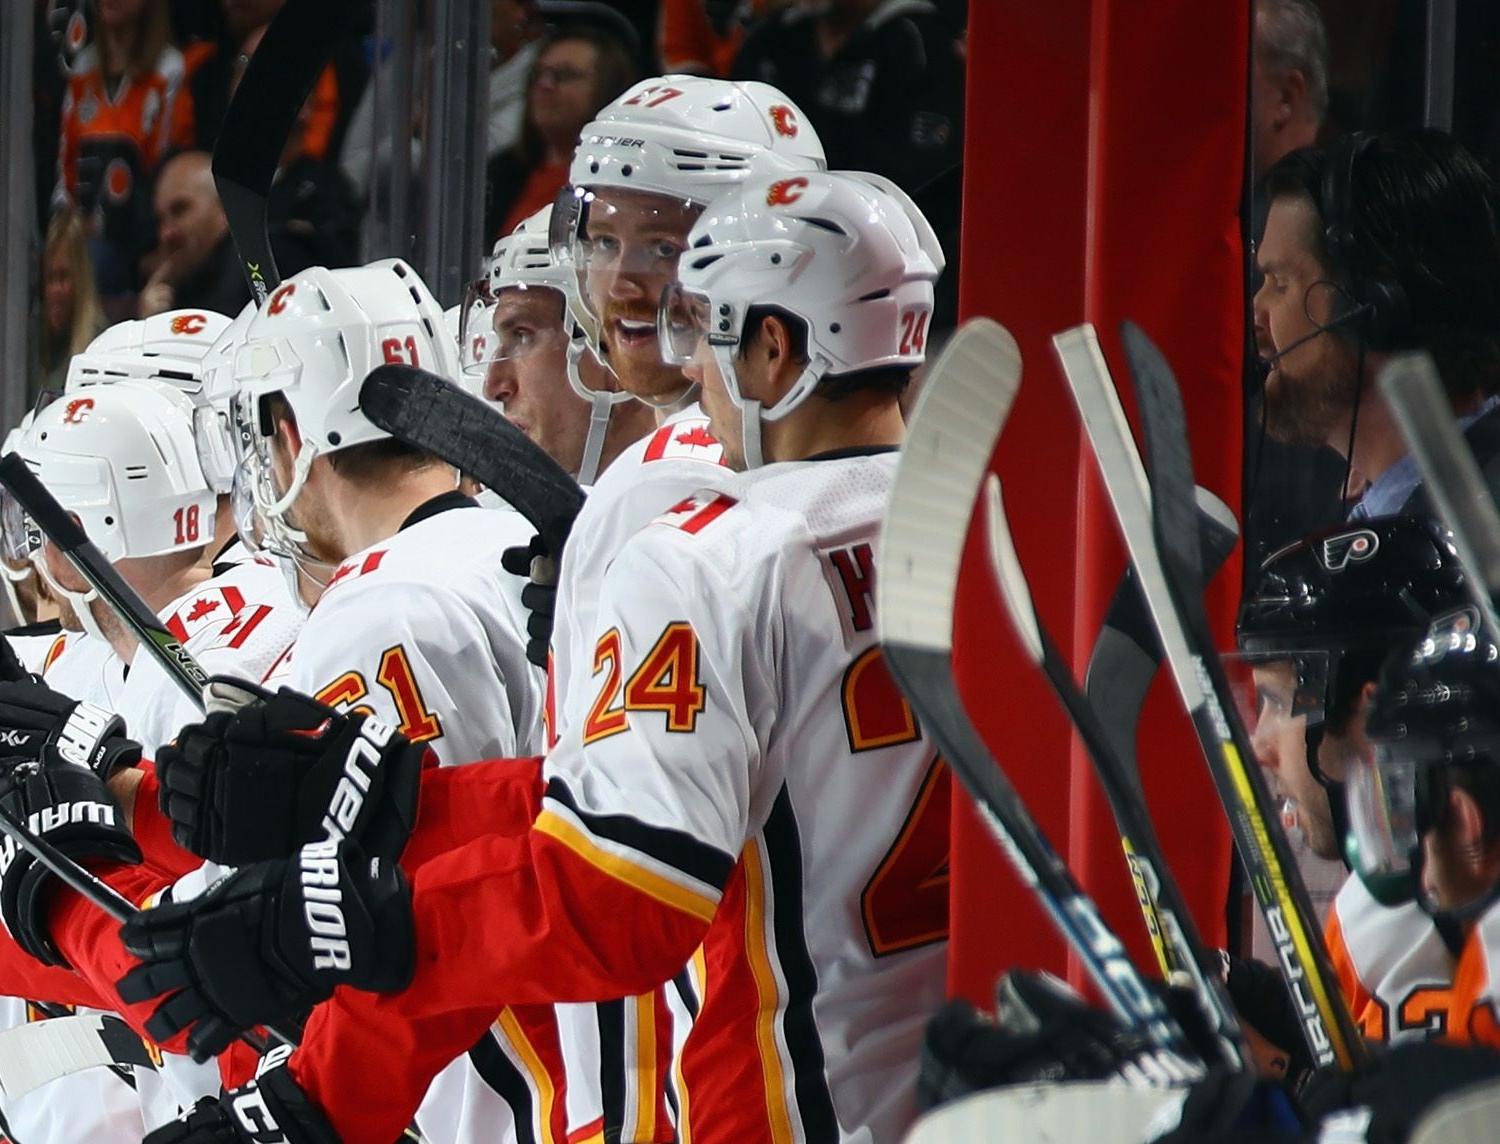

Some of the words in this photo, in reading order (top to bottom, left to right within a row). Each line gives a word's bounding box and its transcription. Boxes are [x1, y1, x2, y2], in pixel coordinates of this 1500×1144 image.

[900, 311, 930, 355] 24
[173, 505, 200, 545] 18
[583, 620, 706, 747] 24
